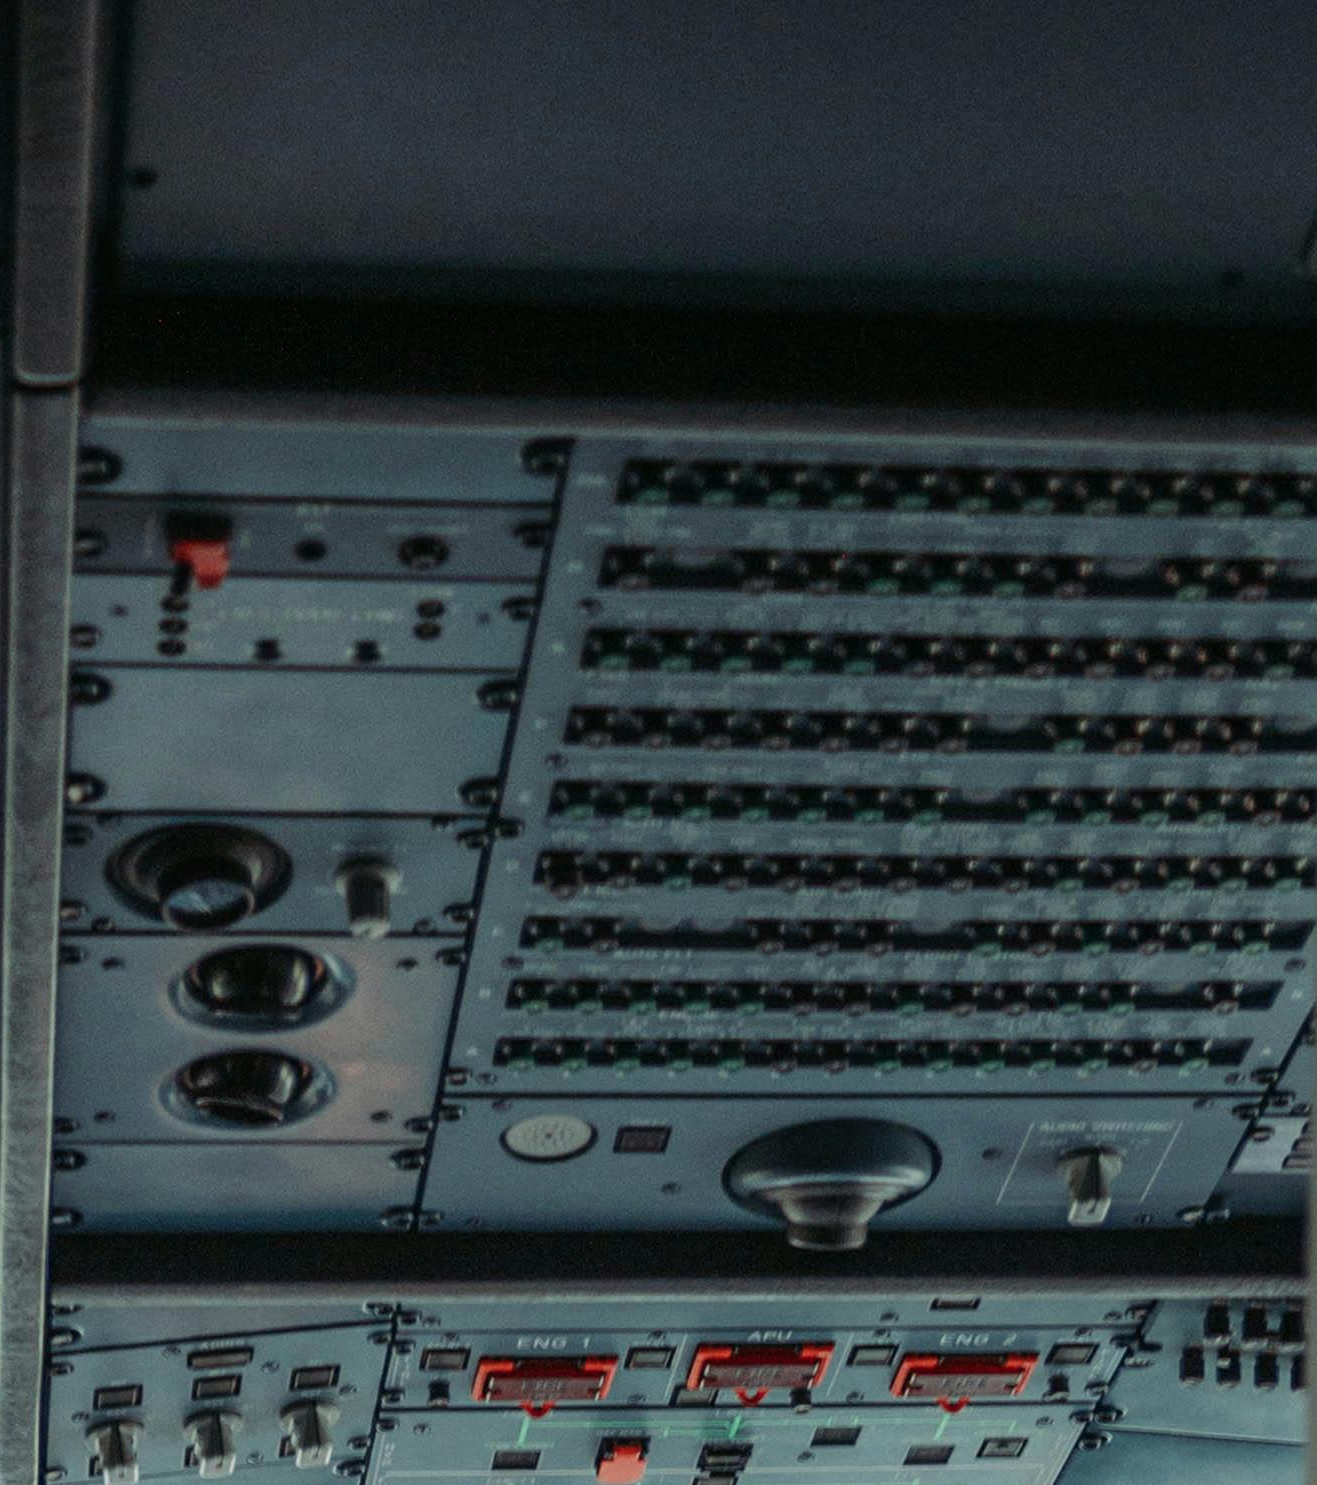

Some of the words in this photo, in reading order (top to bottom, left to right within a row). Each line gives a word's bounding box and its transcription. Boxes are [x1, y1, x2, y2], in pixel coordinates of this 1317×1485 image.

[516, 1335, 568, 1350] ENG
[583, 1335, 590, 1350] 1
[747, 1330, 794, 1342] APU
[939, 1332, 991, 1347] ENG
[1002, 1332, 1018, 1347] 2
